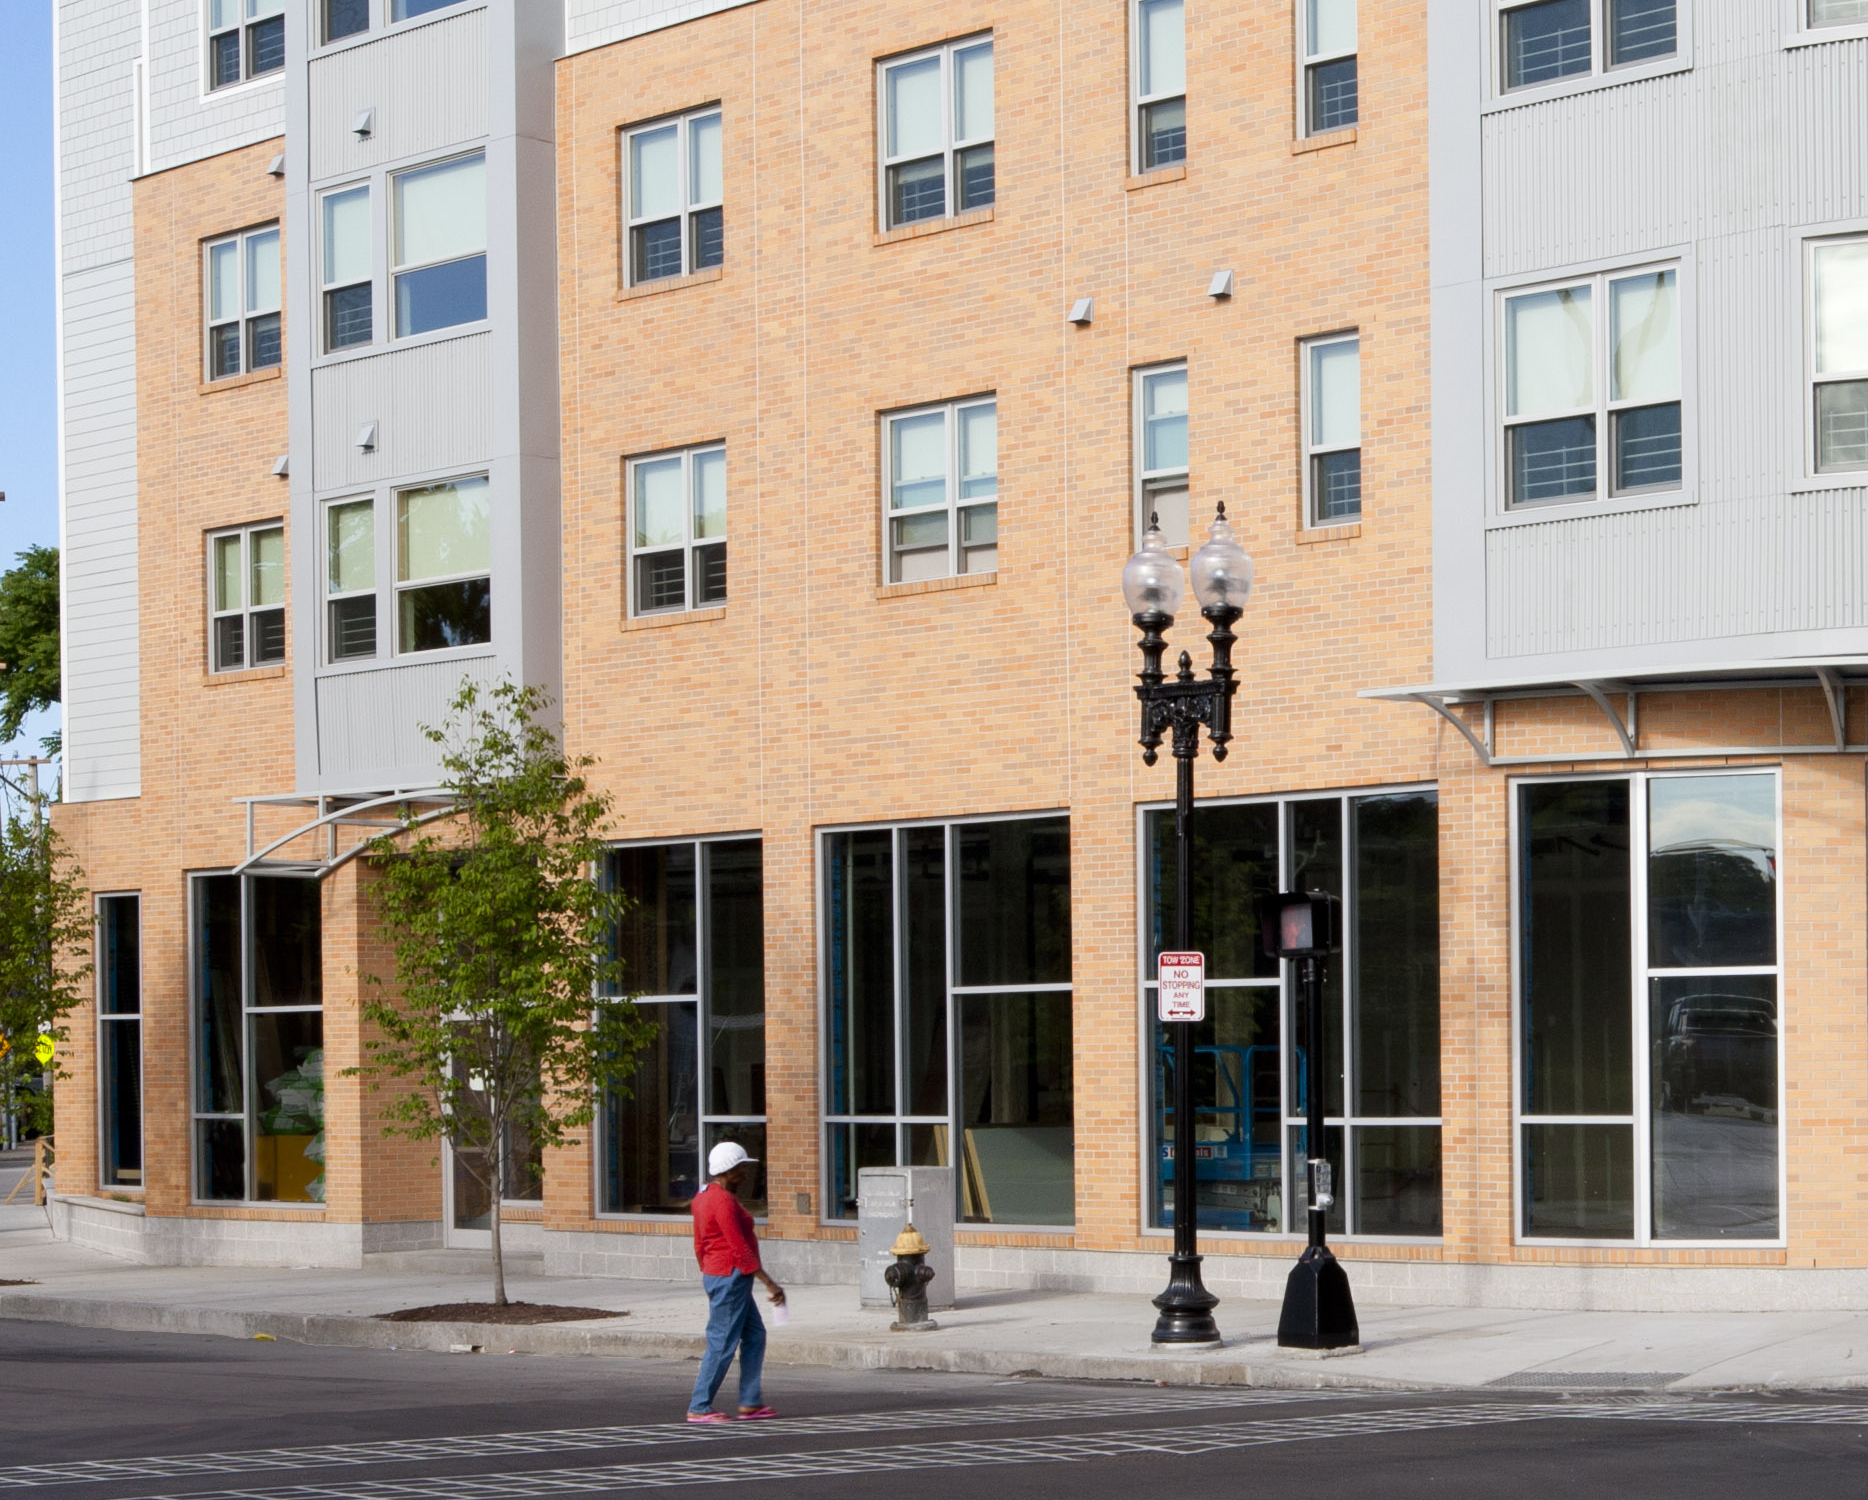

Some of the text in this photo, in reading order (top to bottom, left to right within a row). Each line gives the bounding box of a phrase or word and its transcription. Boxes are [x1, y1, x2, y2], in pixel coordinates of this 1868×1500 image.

[1162, 955, 1200, 965] TOW ZONE
[1173, 970, 1189, 979] NO
[1162, 981, 1200, 990] STOPPING
